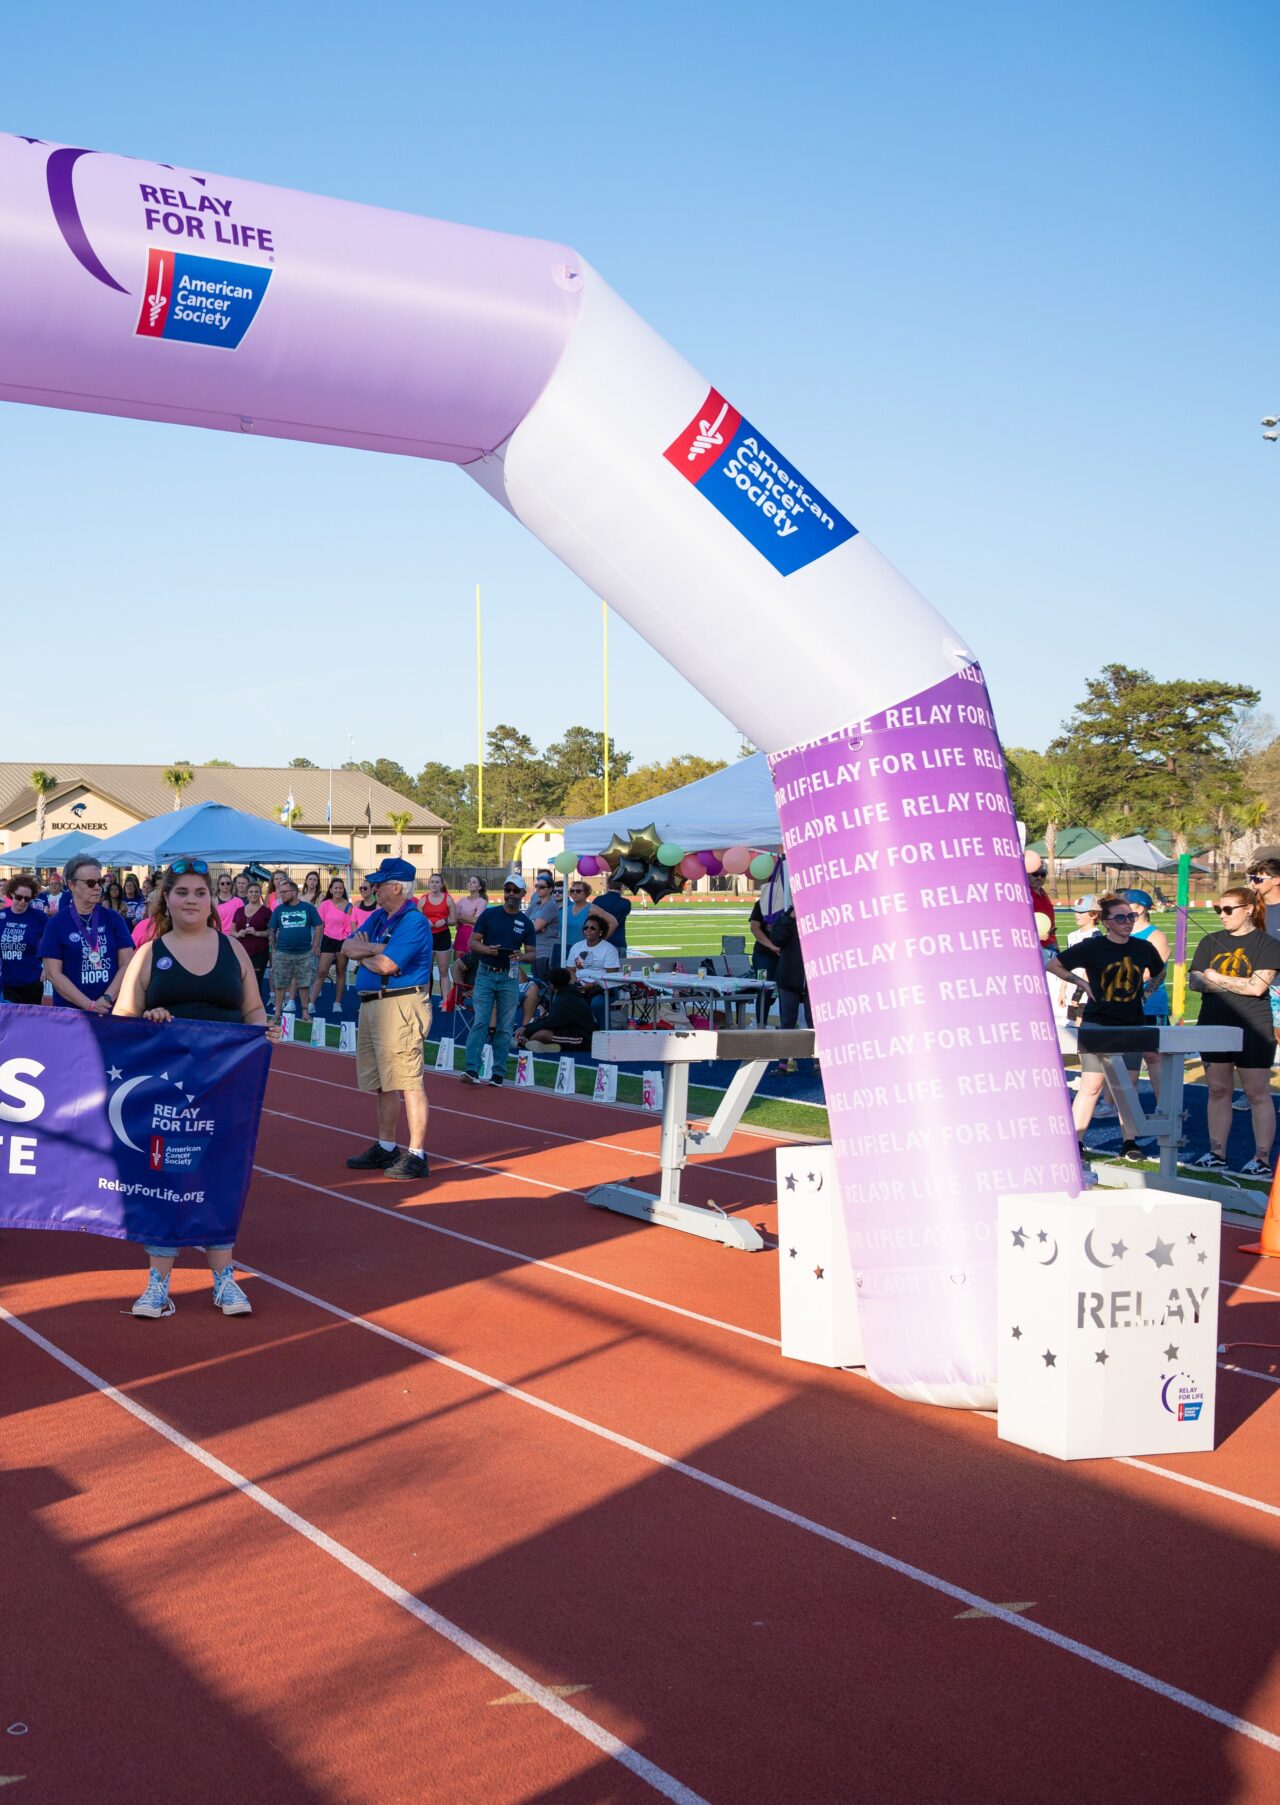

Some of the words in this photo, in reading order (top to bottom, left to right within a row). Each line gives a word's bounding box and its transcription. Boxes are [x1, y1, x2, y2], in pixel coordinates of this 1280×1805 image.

[139, 184, 232, 217] RELAY
[145, 208, 205, 239] FOR
[214, 221, 274, 252] LIFE
[177, 291, 231, 311] Cancer
[179, 275, 253, 299] American
[174, 307, 231, 330] Society
[736, 446, 805, 516] Cancer
[743, 437, 835, 530] American
[723, 459, 799, 537] Society
[886, 705, 952, 729] RELAY
[958, 705, 986, 726] FOR
[868, 752, 918, 777] FOR
[922, 748, 966, 769] LIFE
[973, 748, 1003, 770] REL
[842, 802, 890, 829] LIFE
[902, 792, 969, 817] RELAY
[976, 792, 1006, 812] FOR
[886, 842, 936, 867] FOR
[940, 838, 984, 859] LIFE
[992, 838, 1021, 858] REL
[859, 893, 908, 919] LIFE
[920, 883, 988, 908] RELAY
[994, 883, 1025, 902] FOR
[904, 934, 954, 958] FOR
[960, 929, 1003, 951] LIFE
[1011, 928, 1038, 949] REL
[876, 985, 926, 1010] LIFE
[938, 976, 1007, 1001] RELAY
[1013, 975, 1042, 994] FOR
[923, 1027, 973, 1051] FOR
[978, 1022, 1022, 1045] LIFE
[1030, 1021, 1056, 1040] REL
[894, 1079, 944, 1104] LIFE
[958, 1070, 1026, 1096] RELAY
[1032, 1068, 1060, 1088] FOR
[152, 1118, 181, 1132] FOR
[185, 1120, 215, 1132] LIFE
[154, 1104, 200, 1119] RELAY
[943, 1123, 991, 1146] FOR
[998, 1116, 1041, 1139] LIFE
[1049, 1115, 1075, 1136] REL
[99, 1178, 205, 1202] RelayForLife.org
[912, 1174, 961, 1199] LIFE
[977, 1165, 1045, 1191] RELAY
[1051, 1163, 1078, 1184] FOR
[961, 1222, 999, 1243] FO
[1077, 1287, 1210, 1328] RELAY
